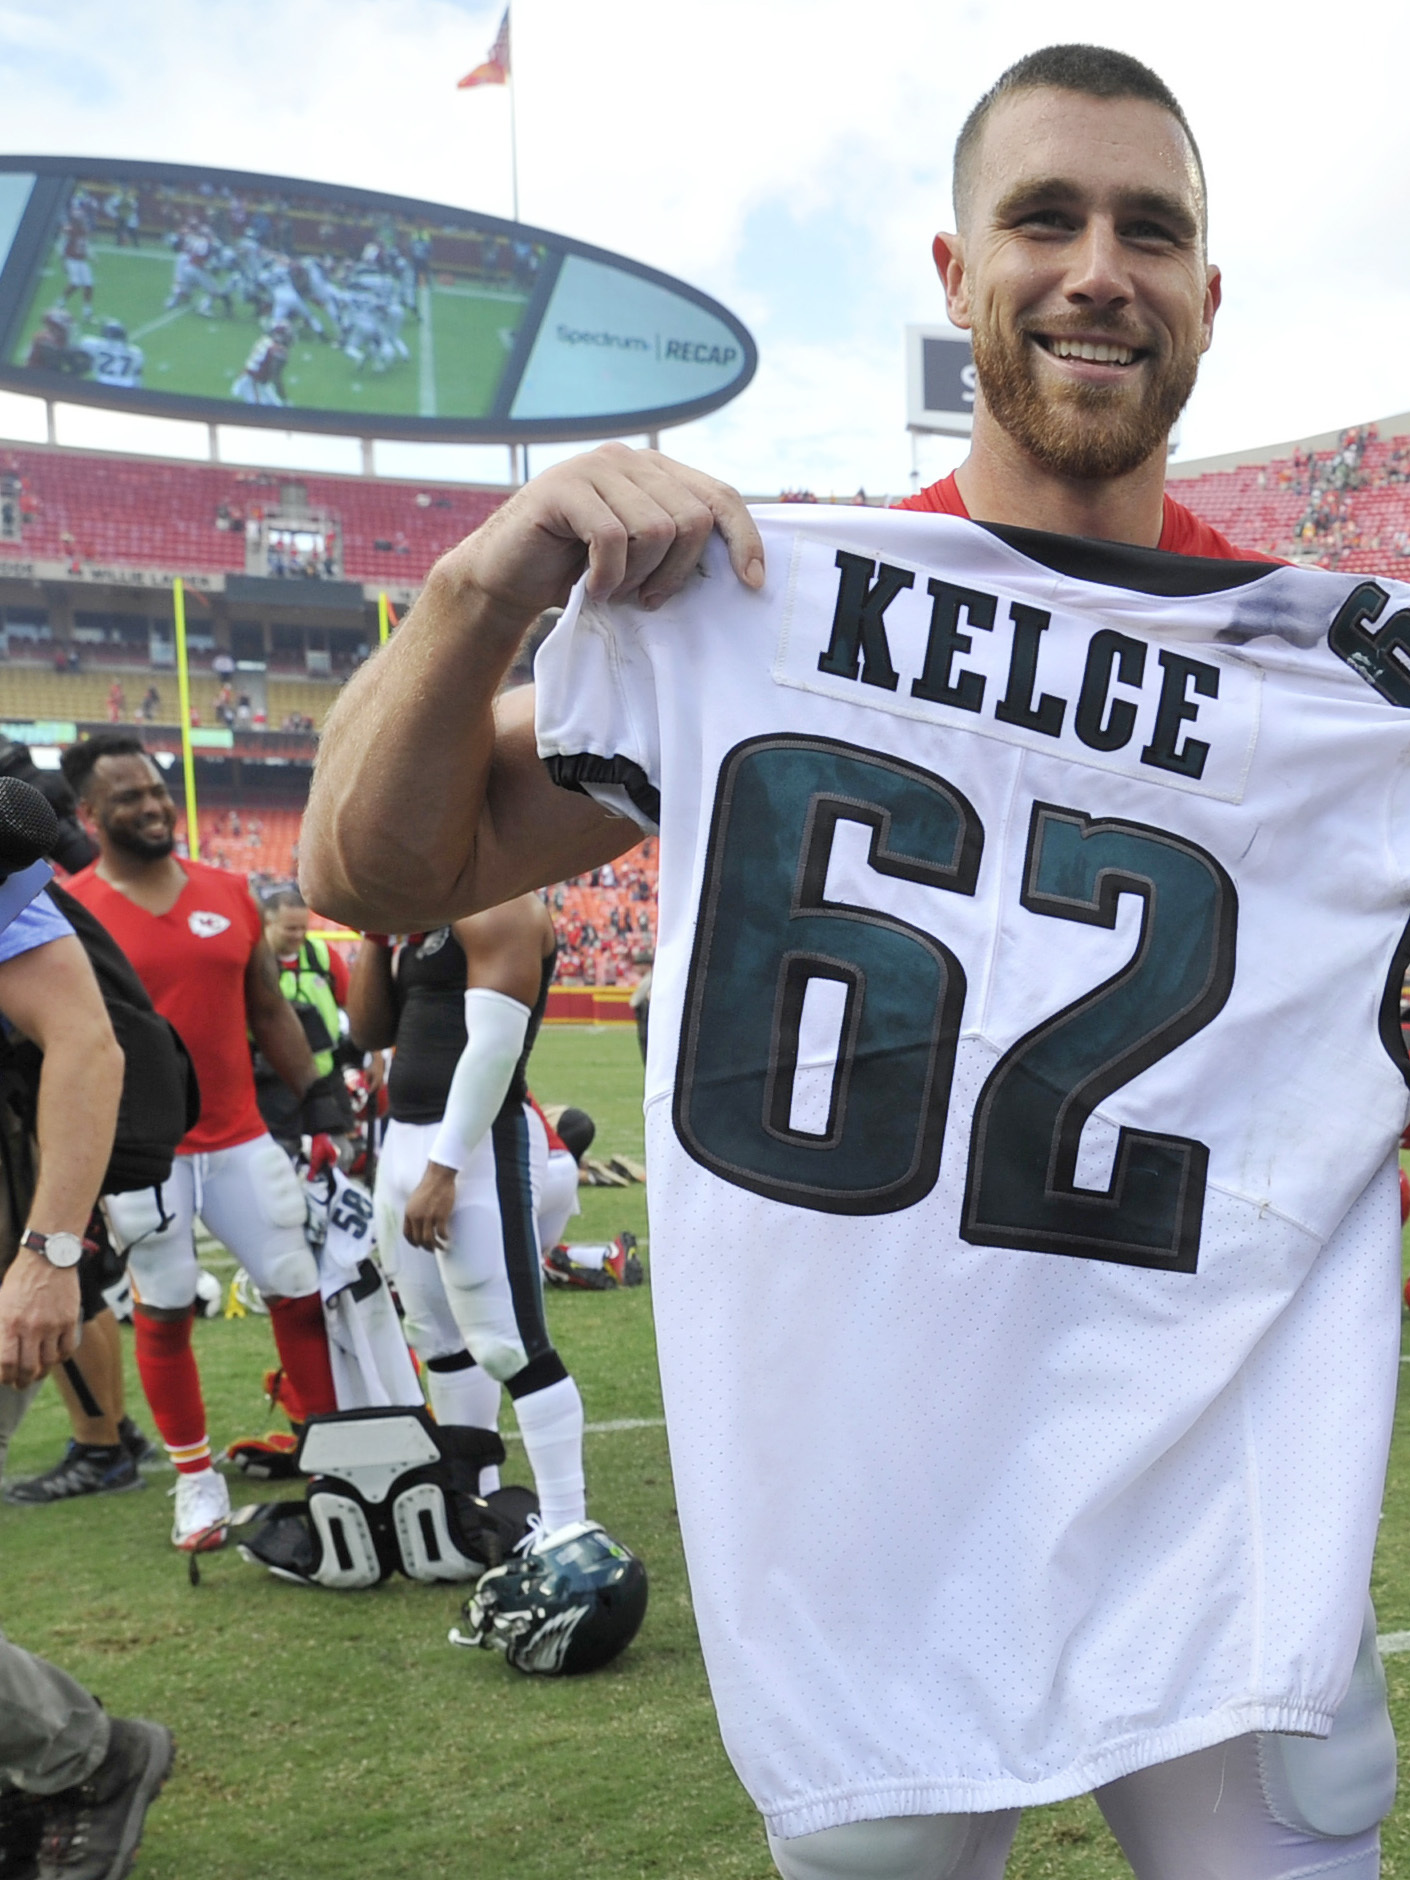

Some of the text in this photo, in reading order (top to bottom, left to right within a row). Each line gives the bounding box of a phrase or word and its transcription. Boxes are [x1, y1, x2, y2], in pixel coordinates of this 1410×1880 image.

[99, 351, 133, 376] 27
[556, 324, 737, 366] Spectrum RECAP
[818, 549, 1221, 780] KELCE
[671, 732, 1239, 1274] 62
[331, 1188, 374, 1240] 58
